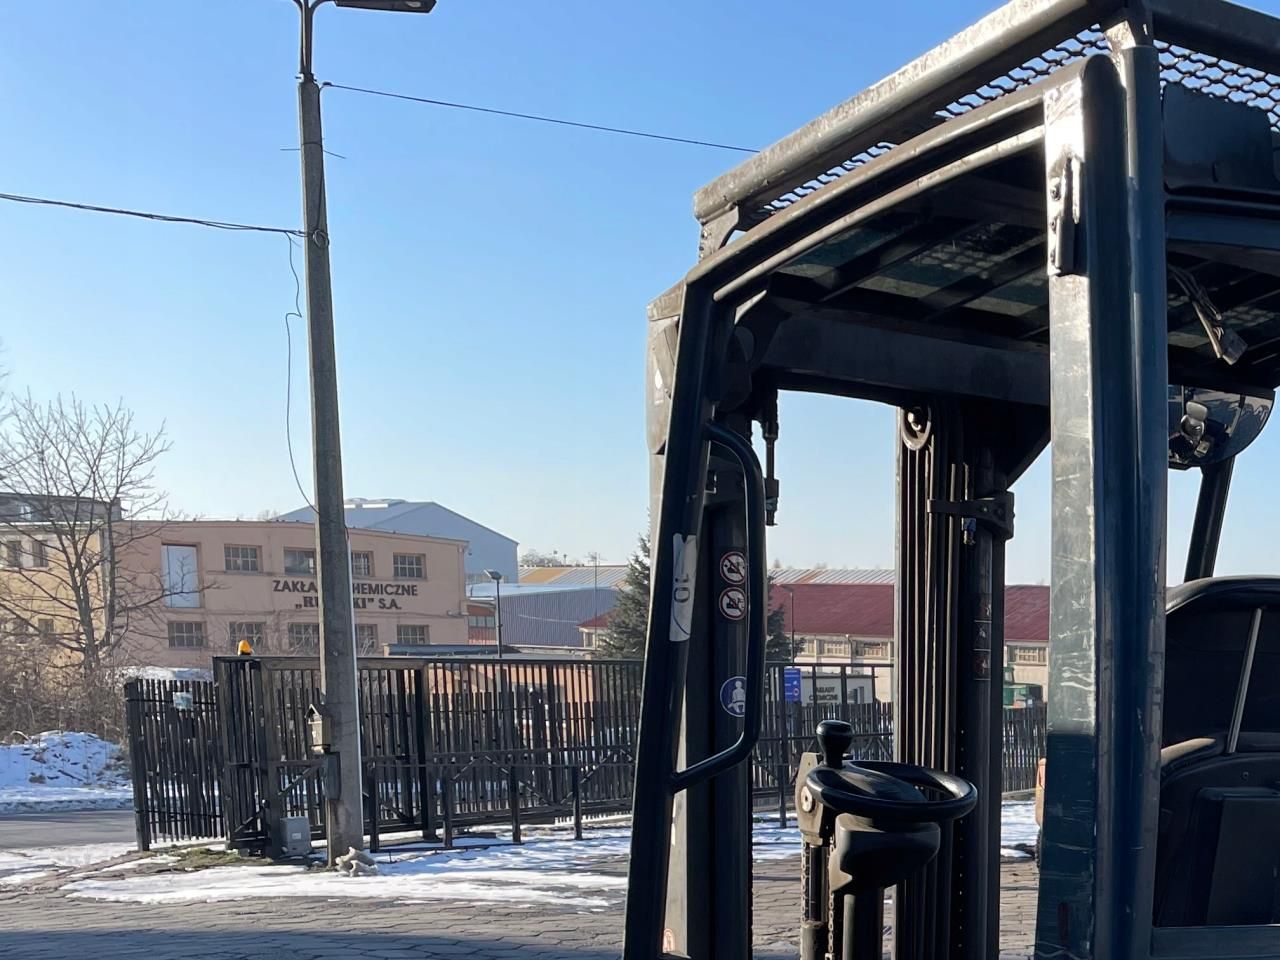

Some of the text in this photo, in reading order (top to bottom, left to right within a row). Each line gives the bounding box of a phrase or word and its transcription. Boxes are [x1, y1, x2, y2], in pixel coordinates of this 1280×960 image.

[272, 579, 419, 597] ZAKŁA HEMICZNE
[378, 597, 402, 610] S.A.
